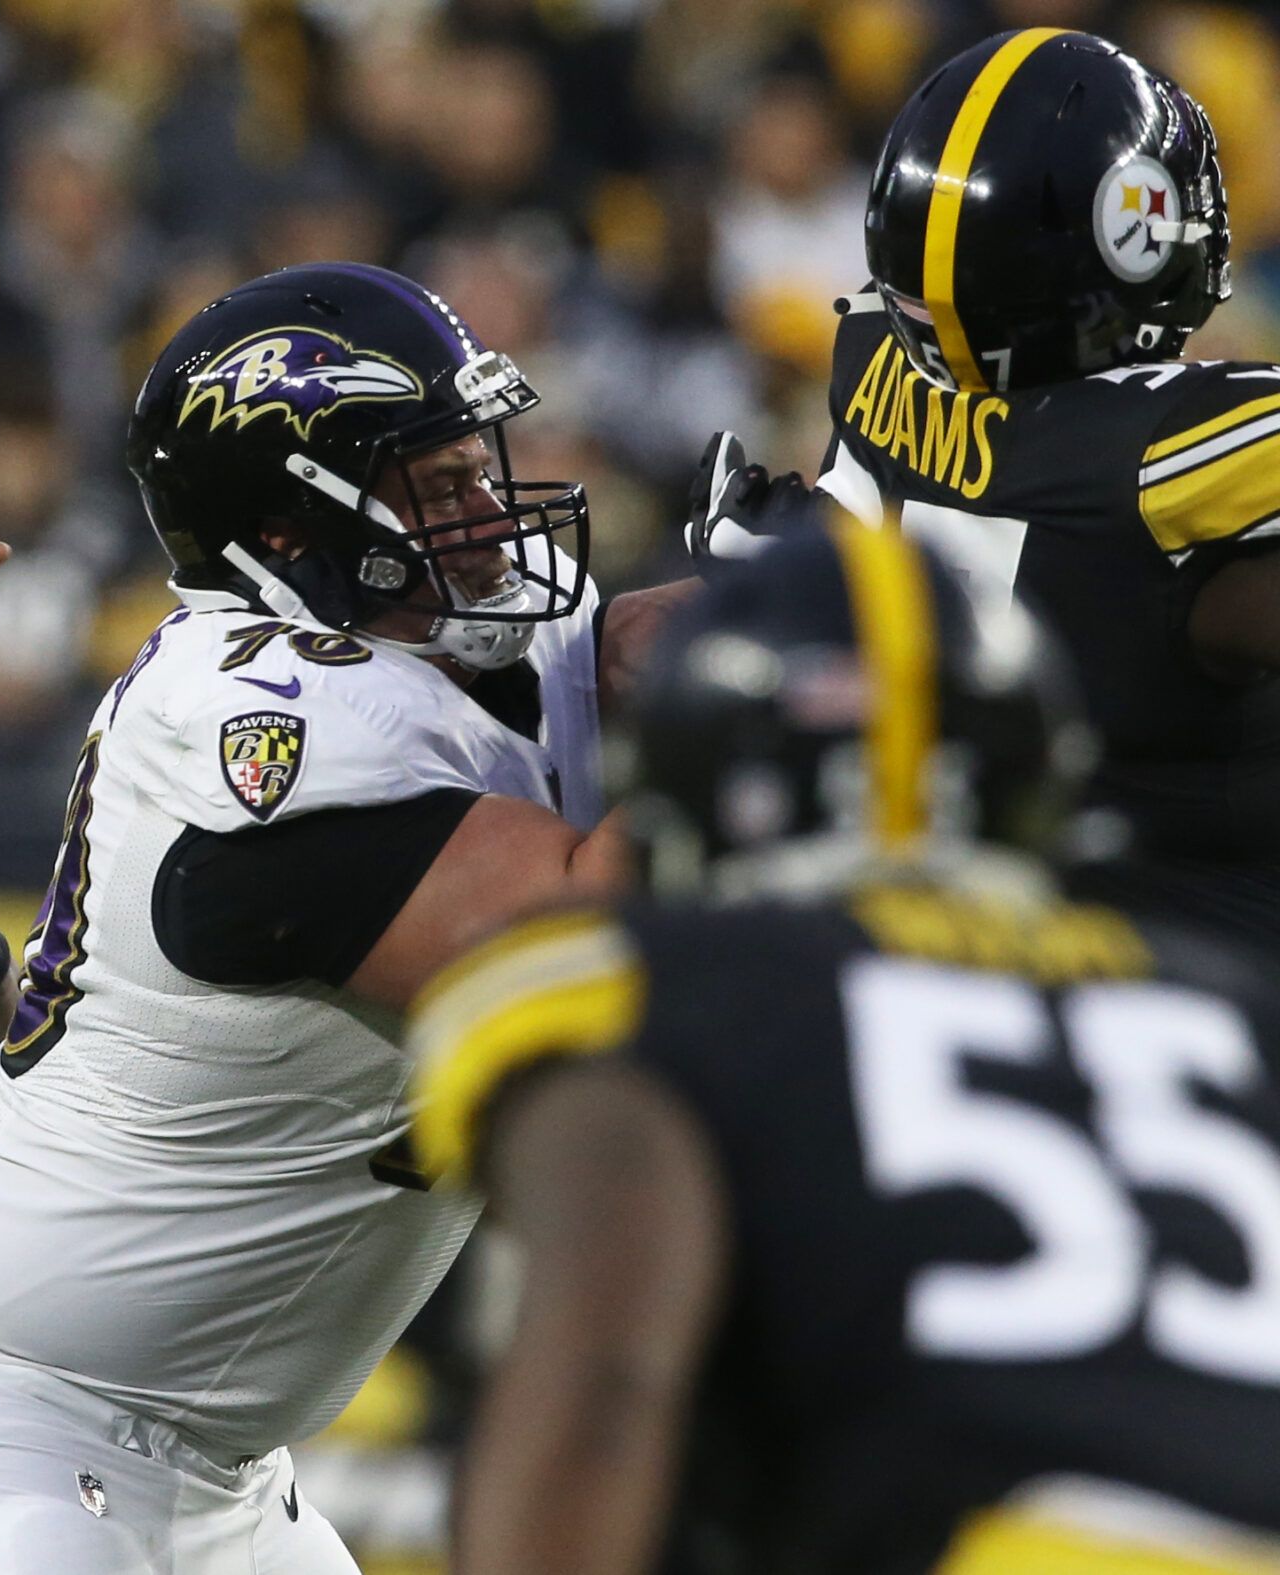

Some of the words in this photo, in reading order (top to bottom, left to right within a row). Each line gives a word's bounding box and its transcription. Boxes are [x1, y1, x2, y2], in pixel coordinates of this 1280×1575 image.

[844, 333, 1009, 499] ADAMS
[224, 716, 298, 734] RAVENS
[837, 953, 1280, 1389] 55
